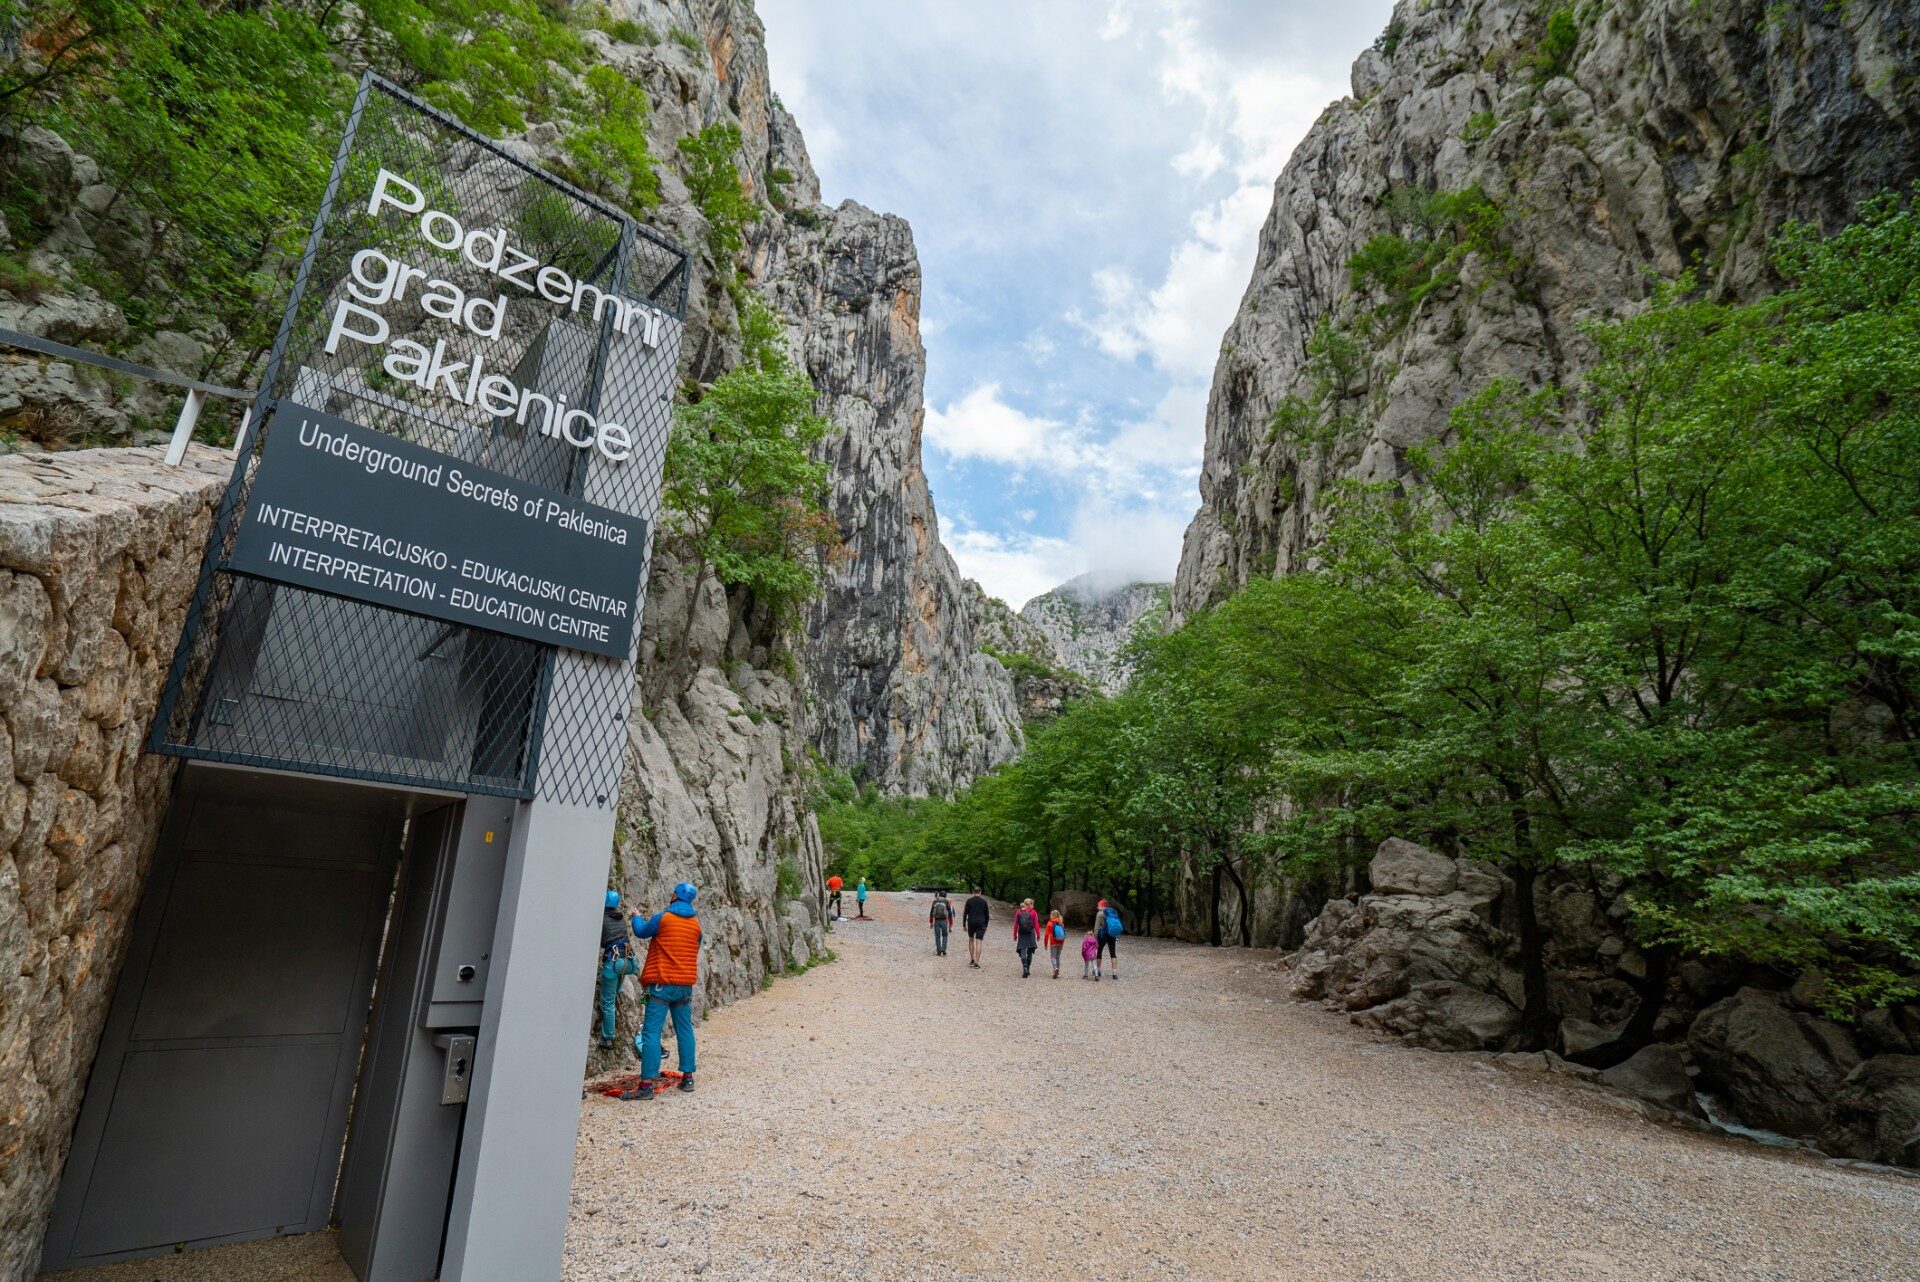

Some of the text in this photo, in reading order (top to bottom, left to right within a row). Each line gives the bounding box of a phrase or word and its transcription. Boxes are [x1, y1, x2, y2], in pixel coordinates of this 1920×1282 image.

[347, 248, 508, 341] grad
[367, 168, 661, 349] Podzemni
[324, 299, 632, 461] Paklenice
[299, 419, 628, 546] Underground Secrets of Paklenica
[257, 503, 448, 571] INTERPRETACIJSKO
[461, 558, 566, 602] EDUKACIJSKI
[568, 588, 628, 619] CENTAR
[268, 542, 437, 601] INTERPRETATION
[449, 588, 545, 629] EDUCATION
[548, 612, 610, 643] CENTRE
